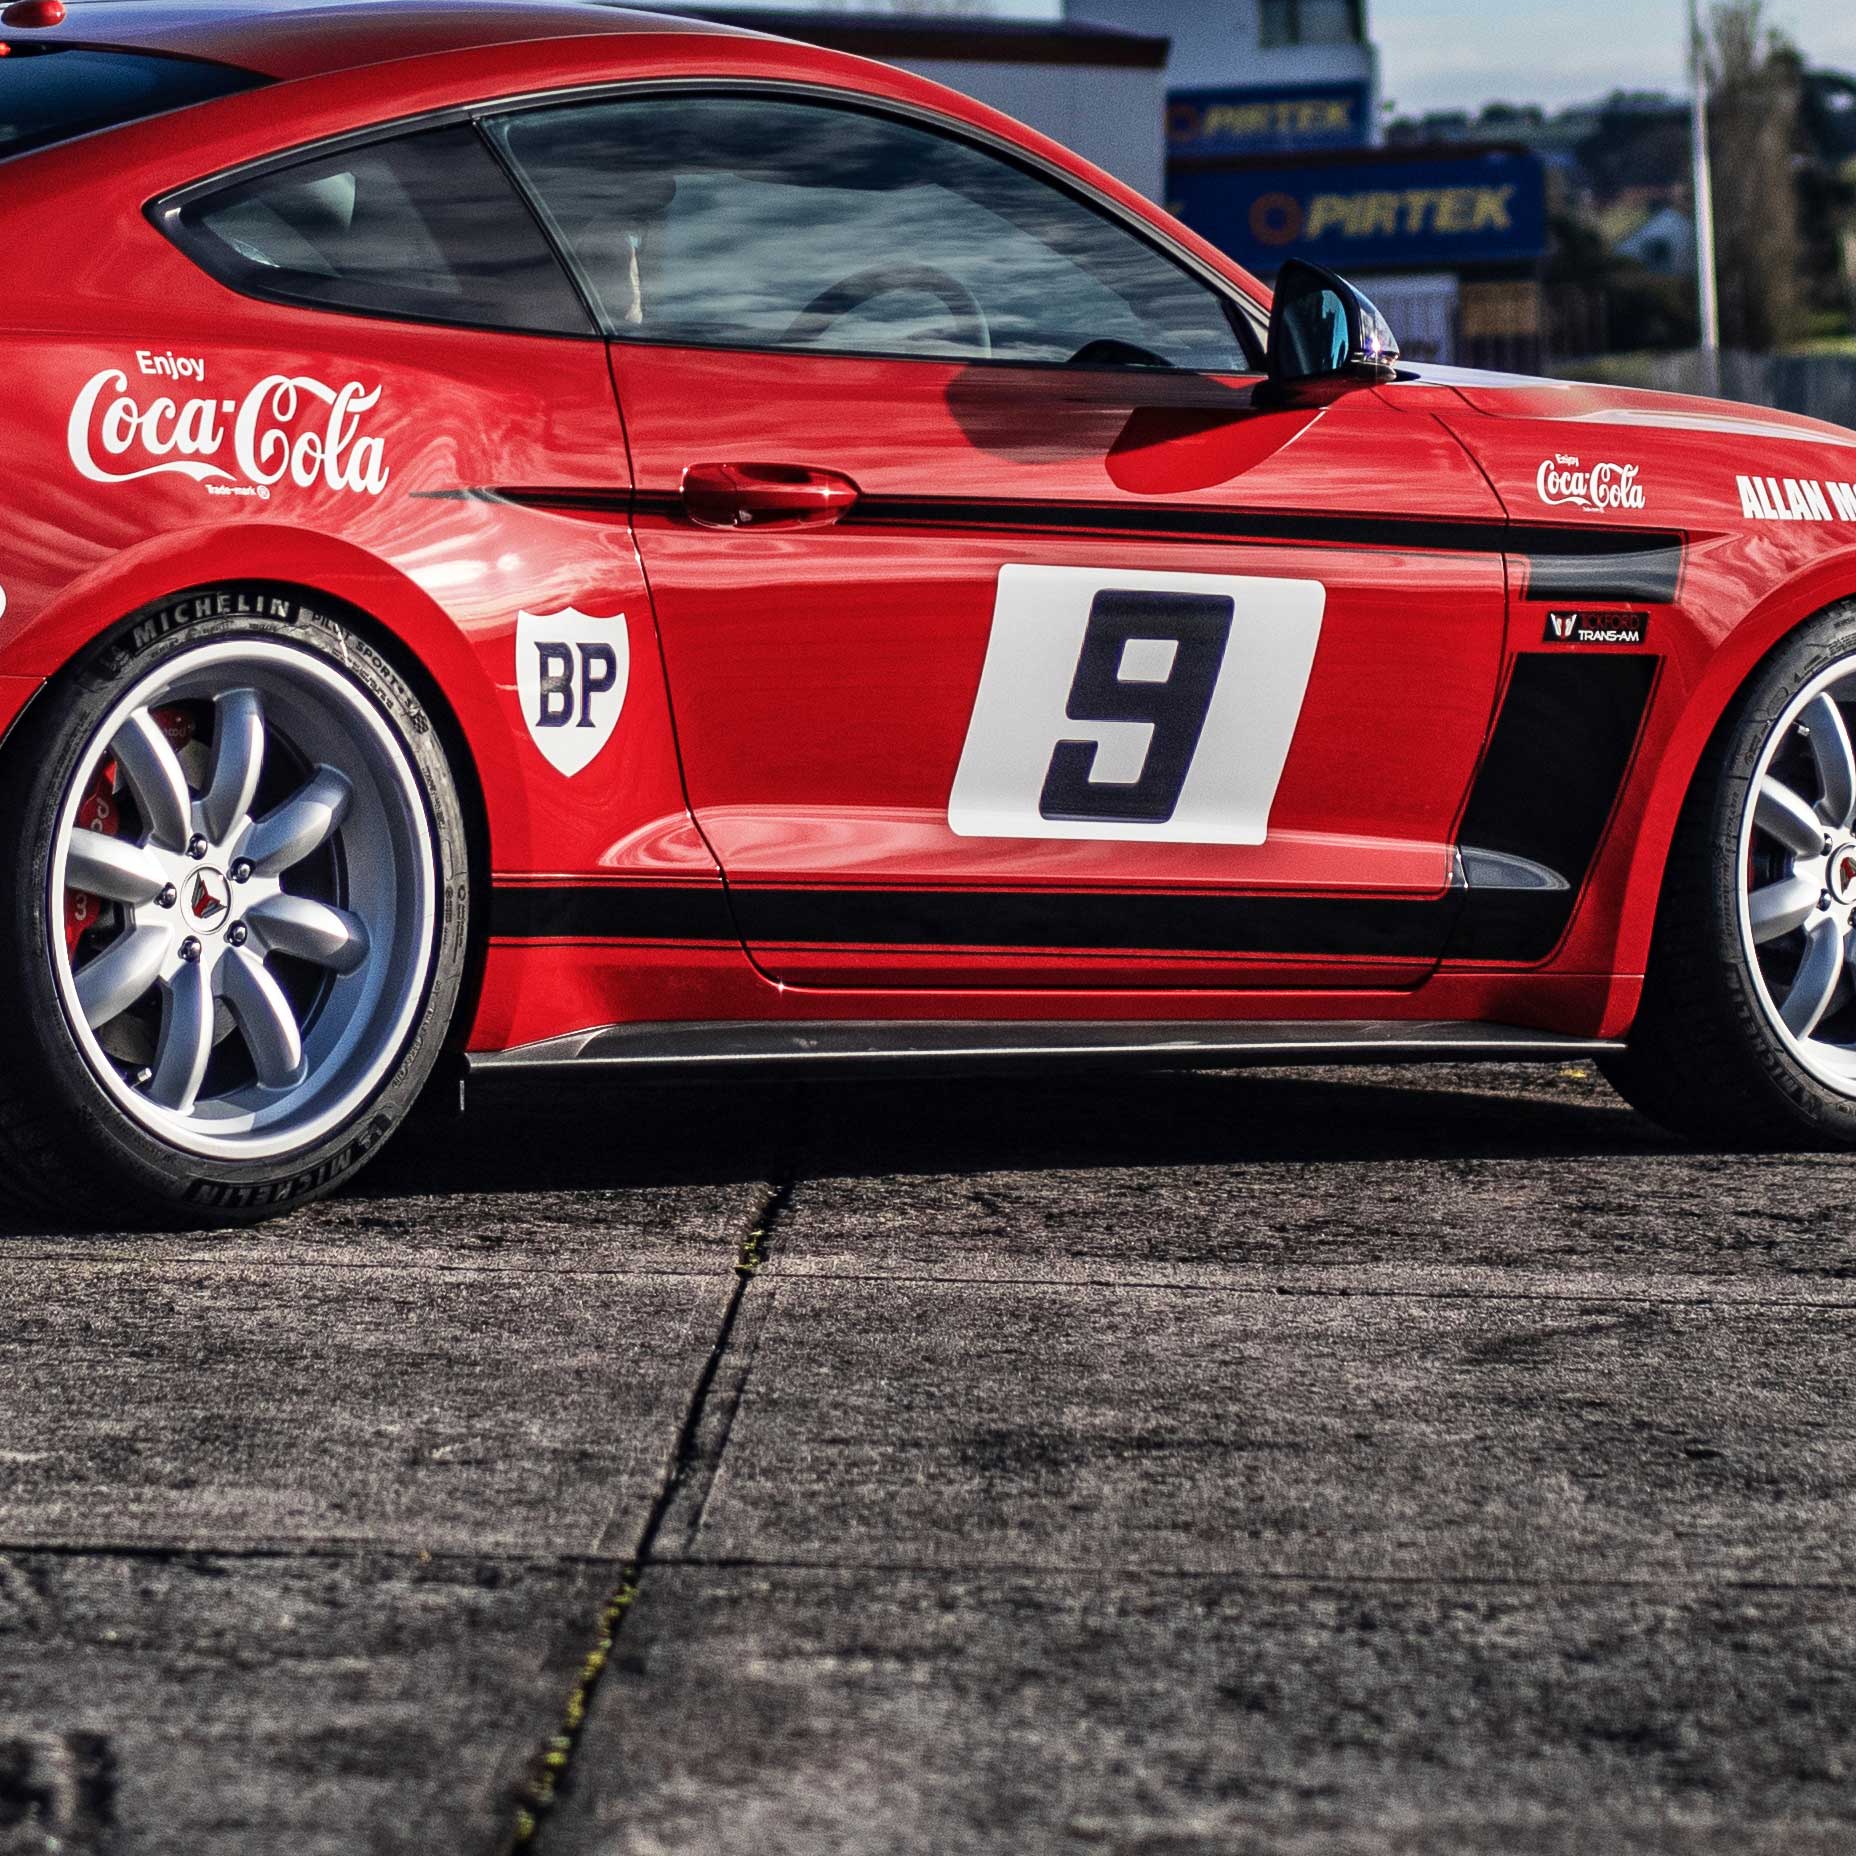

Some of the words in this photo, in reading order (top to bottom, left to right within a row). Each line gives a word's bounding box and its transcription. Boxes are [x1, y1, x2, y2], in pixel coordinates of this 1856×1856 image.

[1205, 101, 1351, 135] PIRTEK
[1304, 182, 1516, 241] PIRTEK
[136, 350, 204, 381] Enjoy
[67, 368, 390, 495] Coca-Cola
[1536, 460, 1646, 509] Coca-Cola
[1735, 475, 1833, 521] ALLAN
[133, 594, 291, 649] MICHELIN
[1578, 630, 1640, 642] TRANS-AM
[356, 640, 400, 685] SPORT
[534, 640, 617, 728] BP
[1039, 589, 1235, 824] 9
